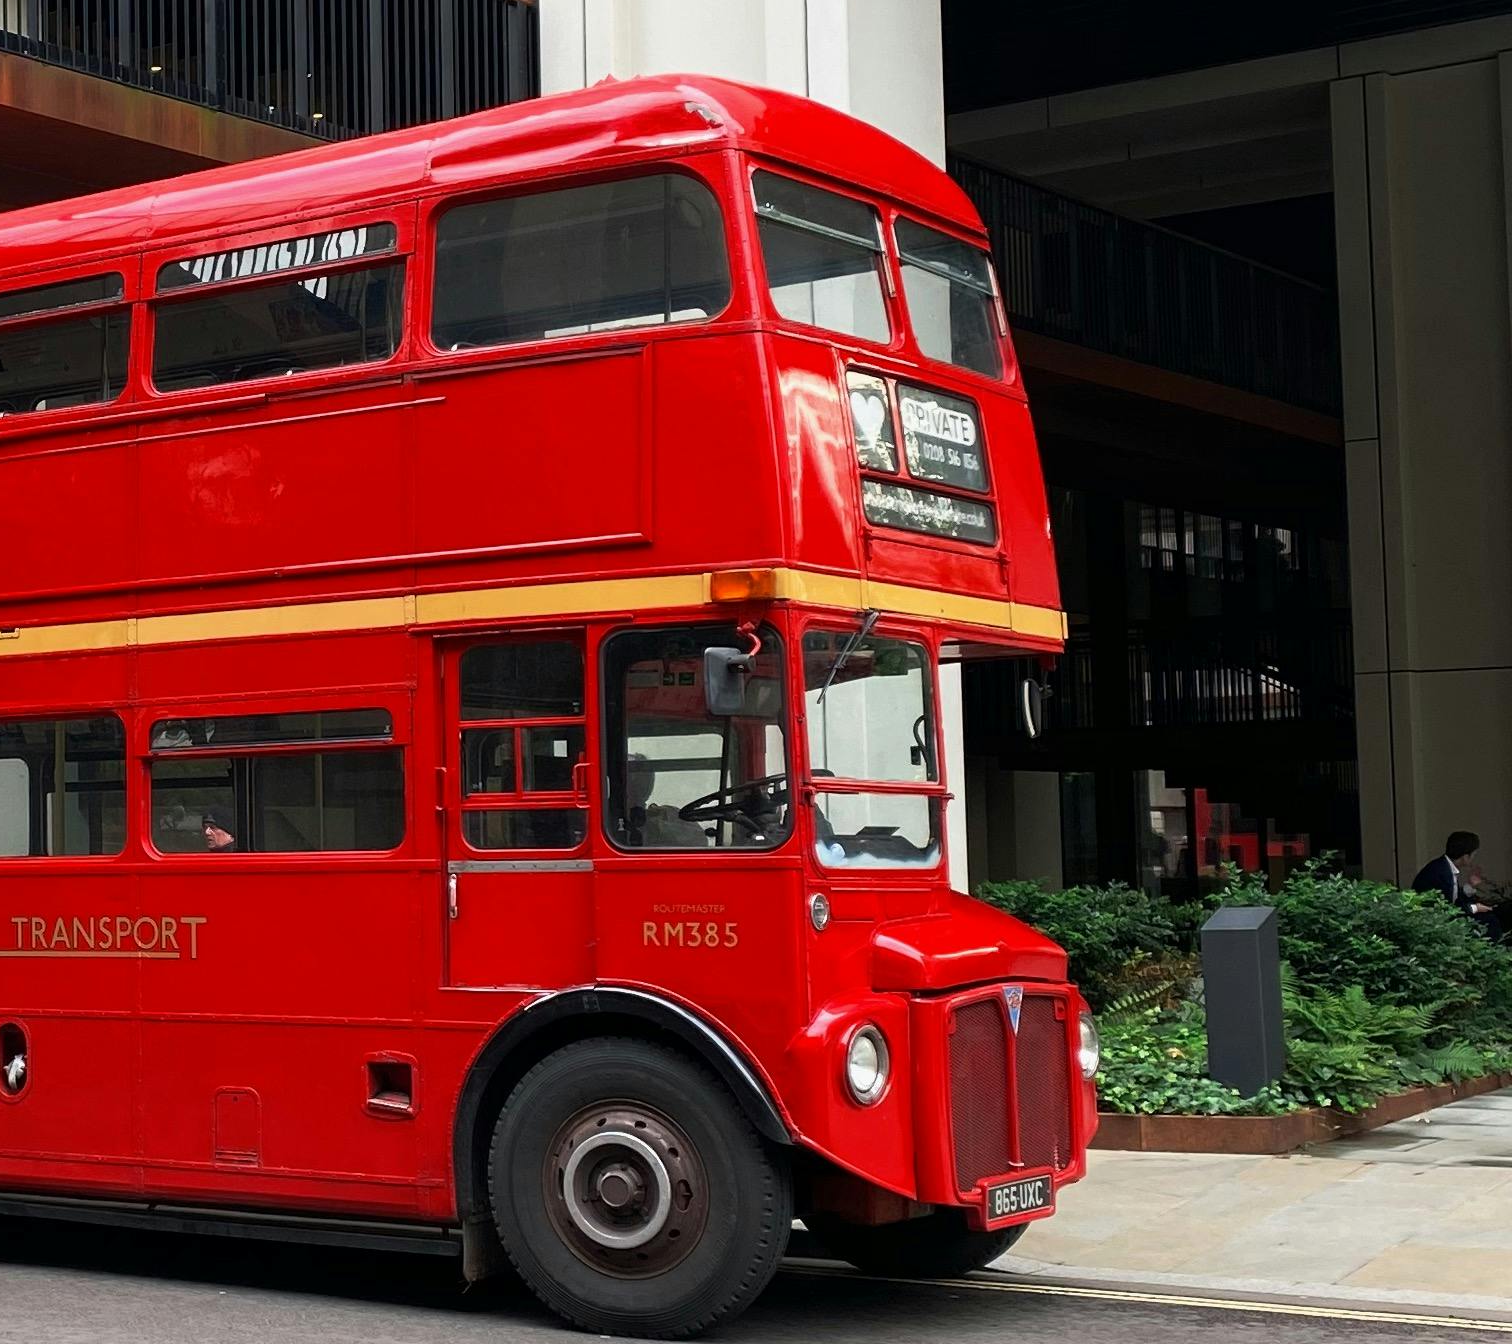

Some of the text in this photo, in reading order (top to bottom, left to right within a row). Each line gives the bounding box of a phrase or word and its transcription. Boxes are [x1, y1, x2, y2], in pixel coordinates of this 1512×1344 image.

[653, 904, 725, 913] ROUTEMASTER
[11, 916, 207, 958] TRANSPORT
[643, 921, 738, 947] RM385
